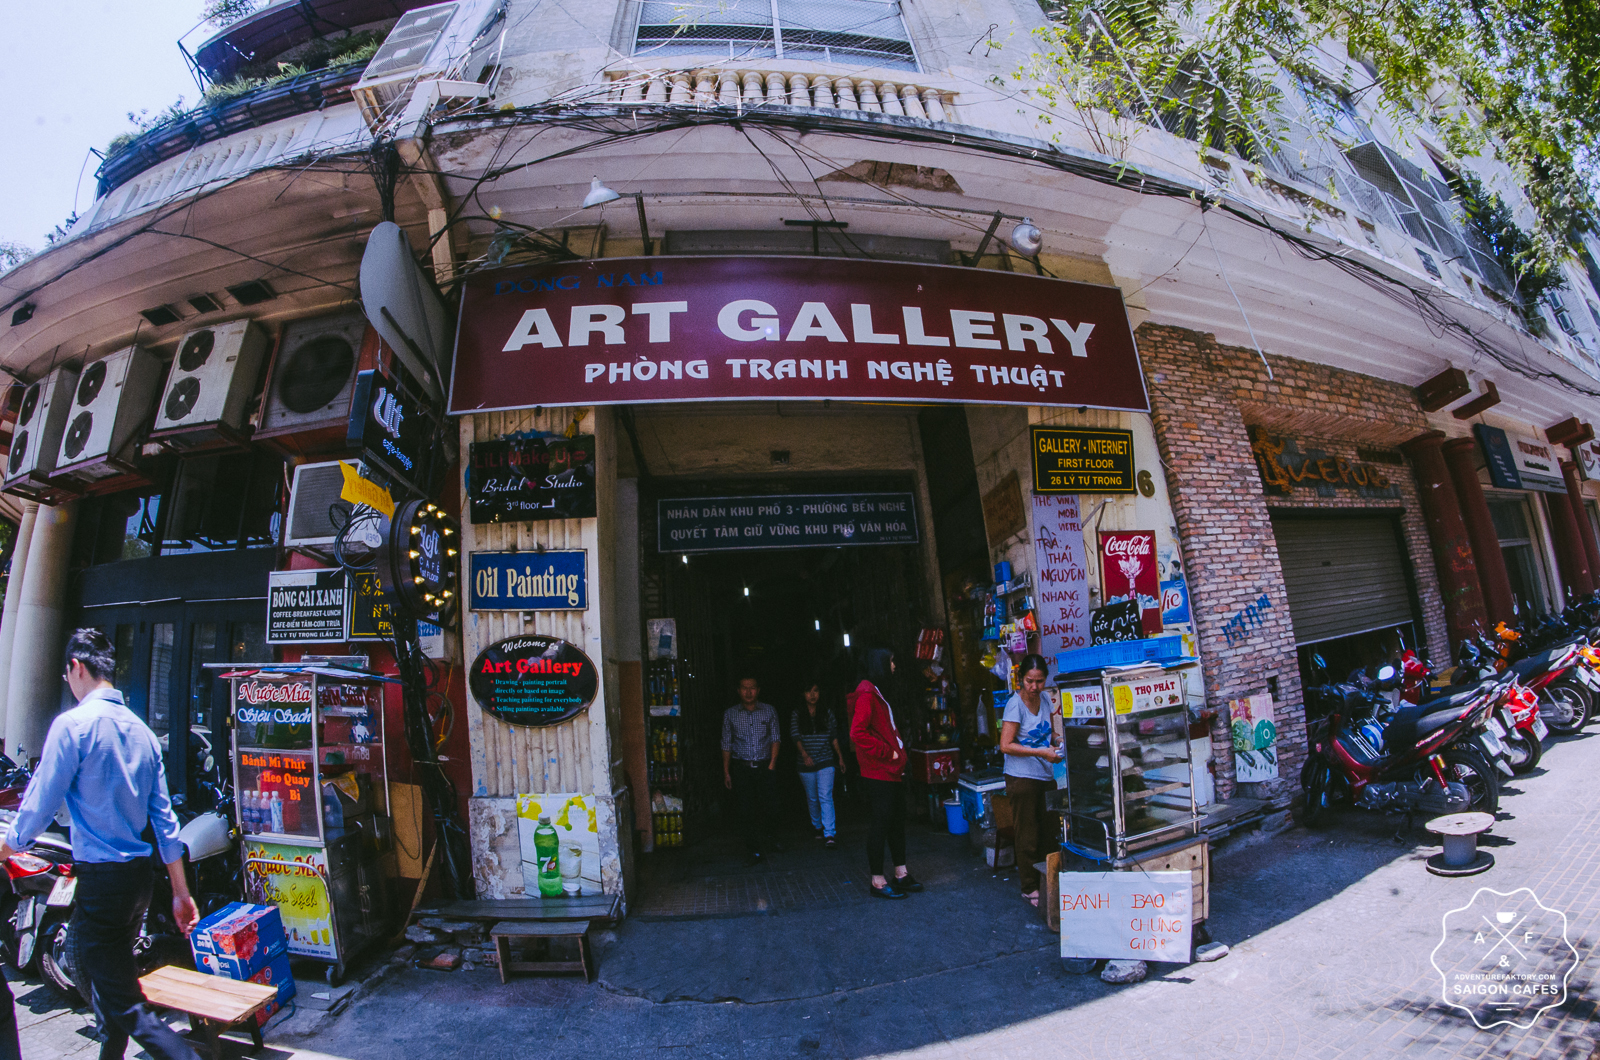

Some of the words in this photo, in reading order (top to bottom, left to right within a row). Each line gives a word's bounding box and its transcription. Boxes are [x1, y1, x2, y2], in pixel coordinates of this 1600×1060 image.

[597, 271, 664, 288] NAM
[501, 301, 688, 352] ART
[717, 299, 1096, 357] GALLERY
[584, 355, 709, 384] PHÒNG
[725, 358, 848, 381] TRANH
[867, 358, 954, 386] NGHỆ
[970, 364, 1066, 392] THUẬT
[1039, 438, 1081, 453] GALLERY
[1088, 440, 1128, 455] INTERNET
[508, 450, 550, 466] Make
[1058, 458, 1083, 468] FIRST
[1086, 459, 1114, 469] FLOOR
[482, 477, 526, 493] Bridal
[540, 474, 583, 489] Studio
[1051, 476, 1061, 485] 26
[1092, 476, 1122, 487] TRỌNG
[520, 501, 540, 510] floor
[667, 505, 698, 519] NHÂN
[702, 504, 726, 518] DÂN
[730, 505, 753, 517] KHU
[786, 505, 794, 515] 3
[714, 524, 739, 538] TÂM
[805, 524, 828, 535] KHU
[420, 523, 439, 558] Loft
[1105, 536, 1151, 556] Coca-Cola
[427, 571, 440, 584] FLOOR
[1041, 563, 1085, 583] NGUYÊN
[476, 566, 499, 598] Oil
[506, 565, 579, 606] Painting
[272, 587, 297, 608] BÔNG
[316, 588, 343, 605] XANH
[1042, 590, 1079, 603] NHANG
[502, 639, 546, 653] Welcome
[1061, 636, 1085, 649] BAO
[481, 659, 513, 674] Art
[516, 658, 583, 677] Gallery
[495, 679, 518, 687] Drawing
[522, 679, 545, 687] painting
[545, 679, 567, 687] portrait
[1135, 685, 1153, 696] THỌ
[1154, 680, 1176, 692] PHÁT
[495, 687, 516, 695] directly
[1086, 691, 1100, 702] PHÁT
[496, 696, 520, 704] Teaching
[521, 697, 543, 705] painting
[496, 705, 514, 713] Selling
[515, 706, 540, 714] paintings
[242, 754, 267, 767] Bánh
[263, 771, 282, 783] Heo
[284, 773, 310, 788] Quay
[1060, 886, 1110, 911] BÁNH
[1131, 894, 1165, 909] BAO
